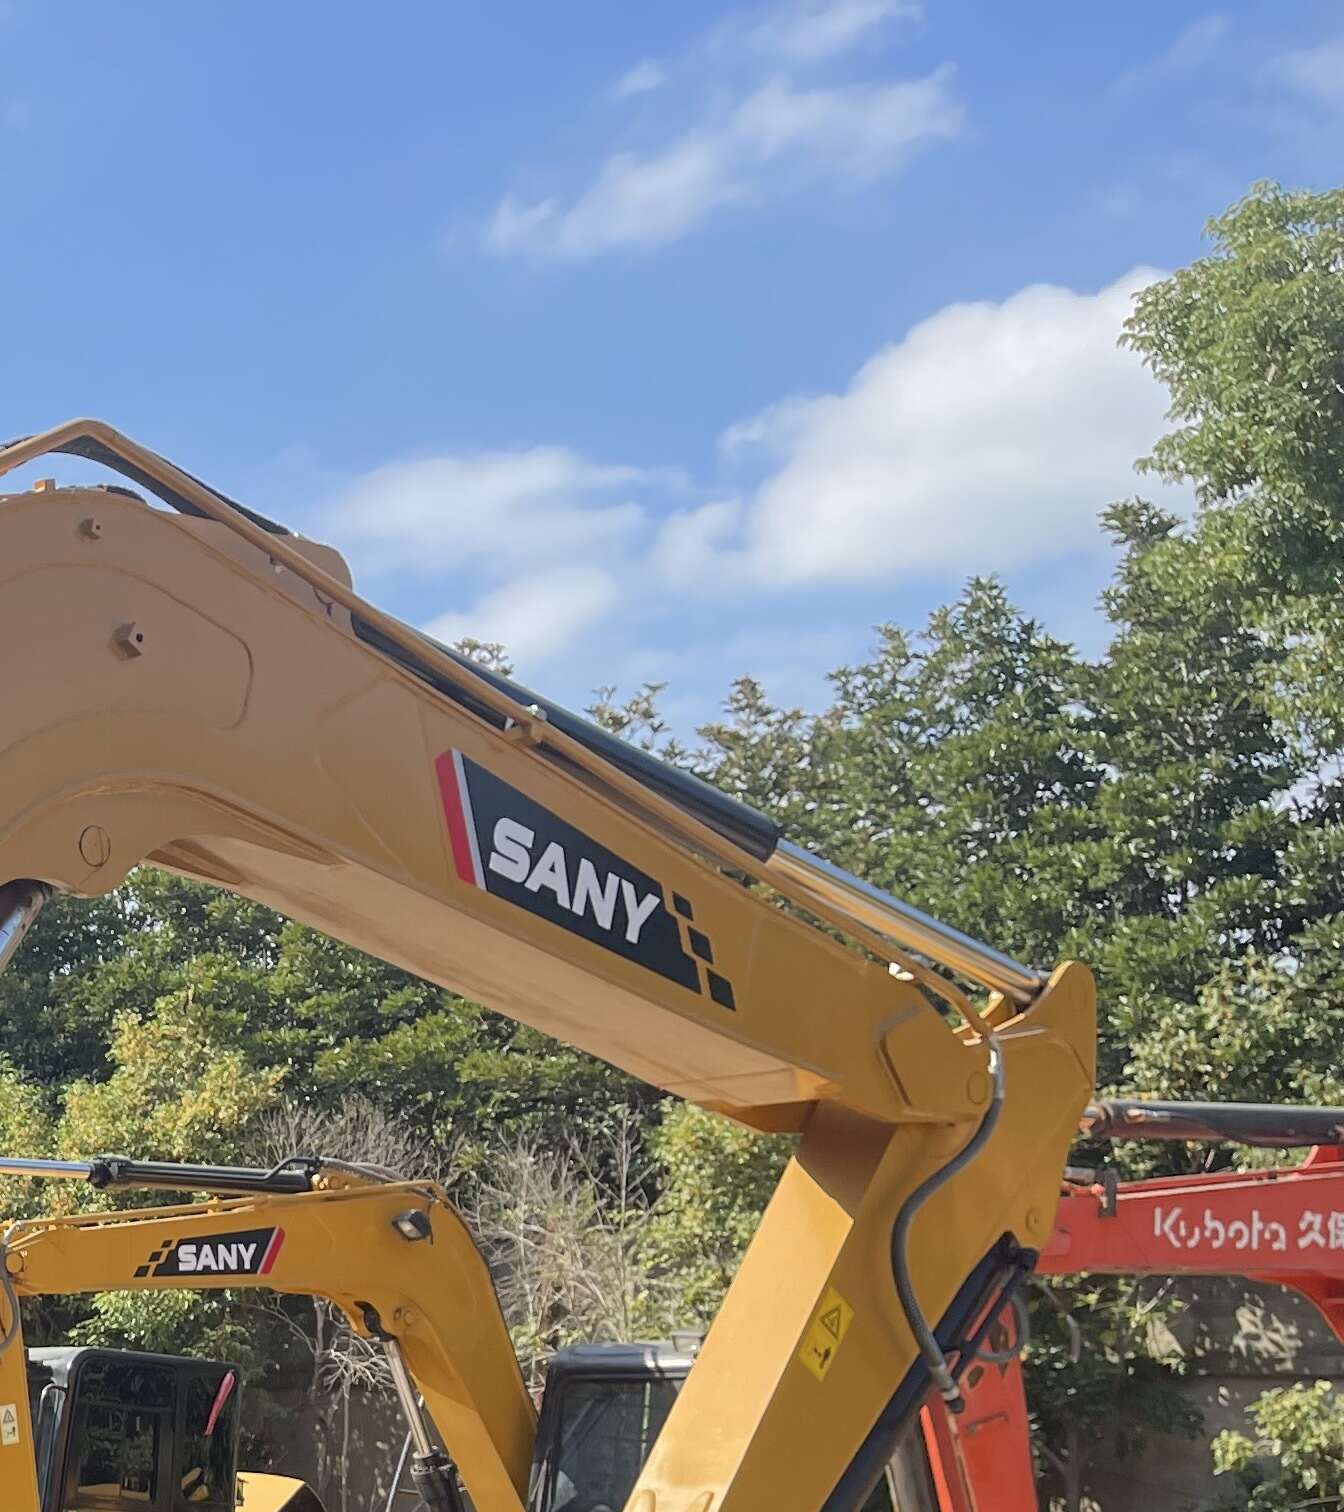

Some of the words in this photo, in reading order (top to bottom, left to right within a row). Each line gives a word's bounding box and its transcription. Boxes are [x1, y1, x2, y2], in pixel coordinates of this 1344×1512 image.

[488, 817, 661, 944] SANY
[1153, 1206, 1287, 1250] Kubota
[177, 1243, 256, 1271] SANY
